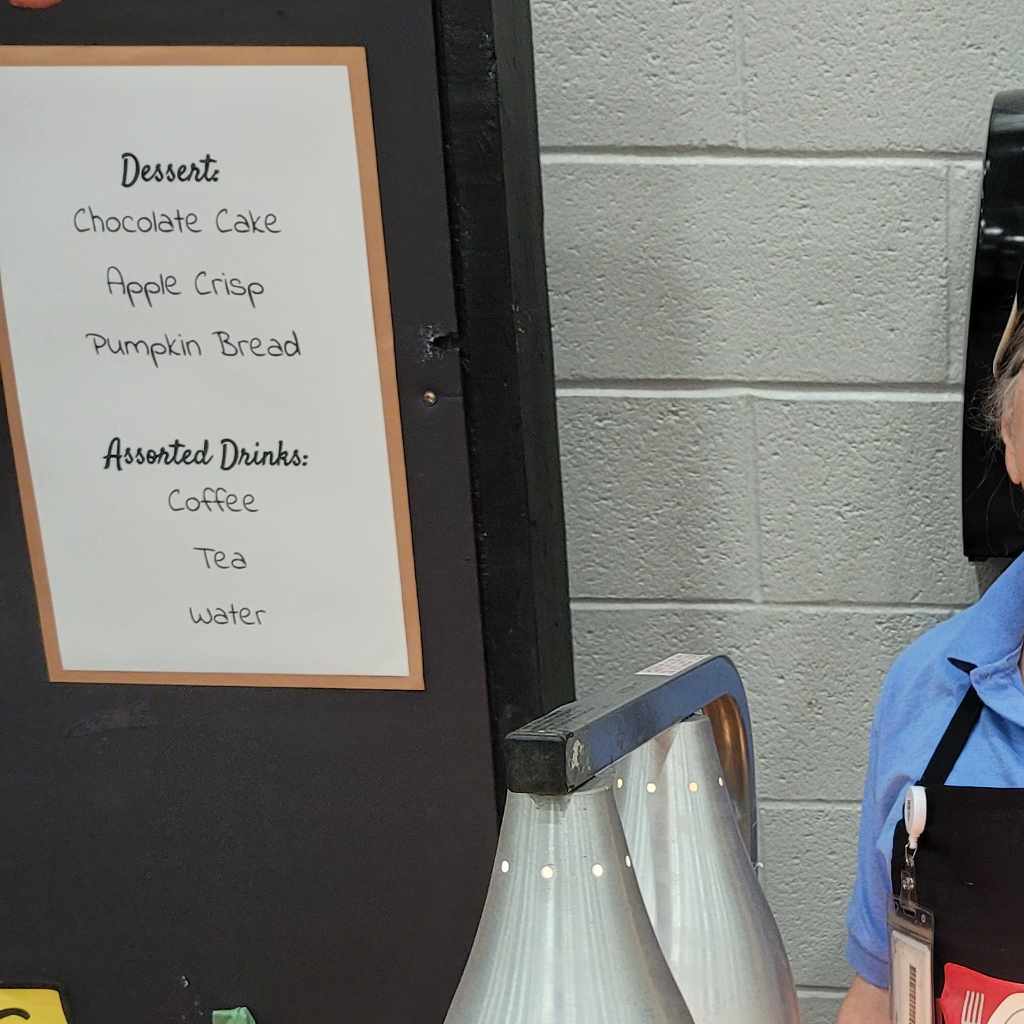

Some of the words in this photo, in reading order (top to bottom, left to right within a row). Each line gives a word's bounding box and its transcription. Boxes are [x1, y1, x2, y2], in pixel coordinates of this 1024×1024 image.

[121, 152, 220, 188] Dessert:
[73, 206, 202, 233] Chocolate
[216, 208, 282, 234] Cake
[107, 266, 182, 308] Apple
[195, 271, 265, 308] Crisp
[85, 333, 202, 368] Pumpkin
[212, 330, 301, 357] Bread
[102, 437, 214, 471] Assorted
[220, 438, 309, 471] Drinks:
[168, 487, 259, 512] Coffee
[193, 547, 247, 569] Tea
